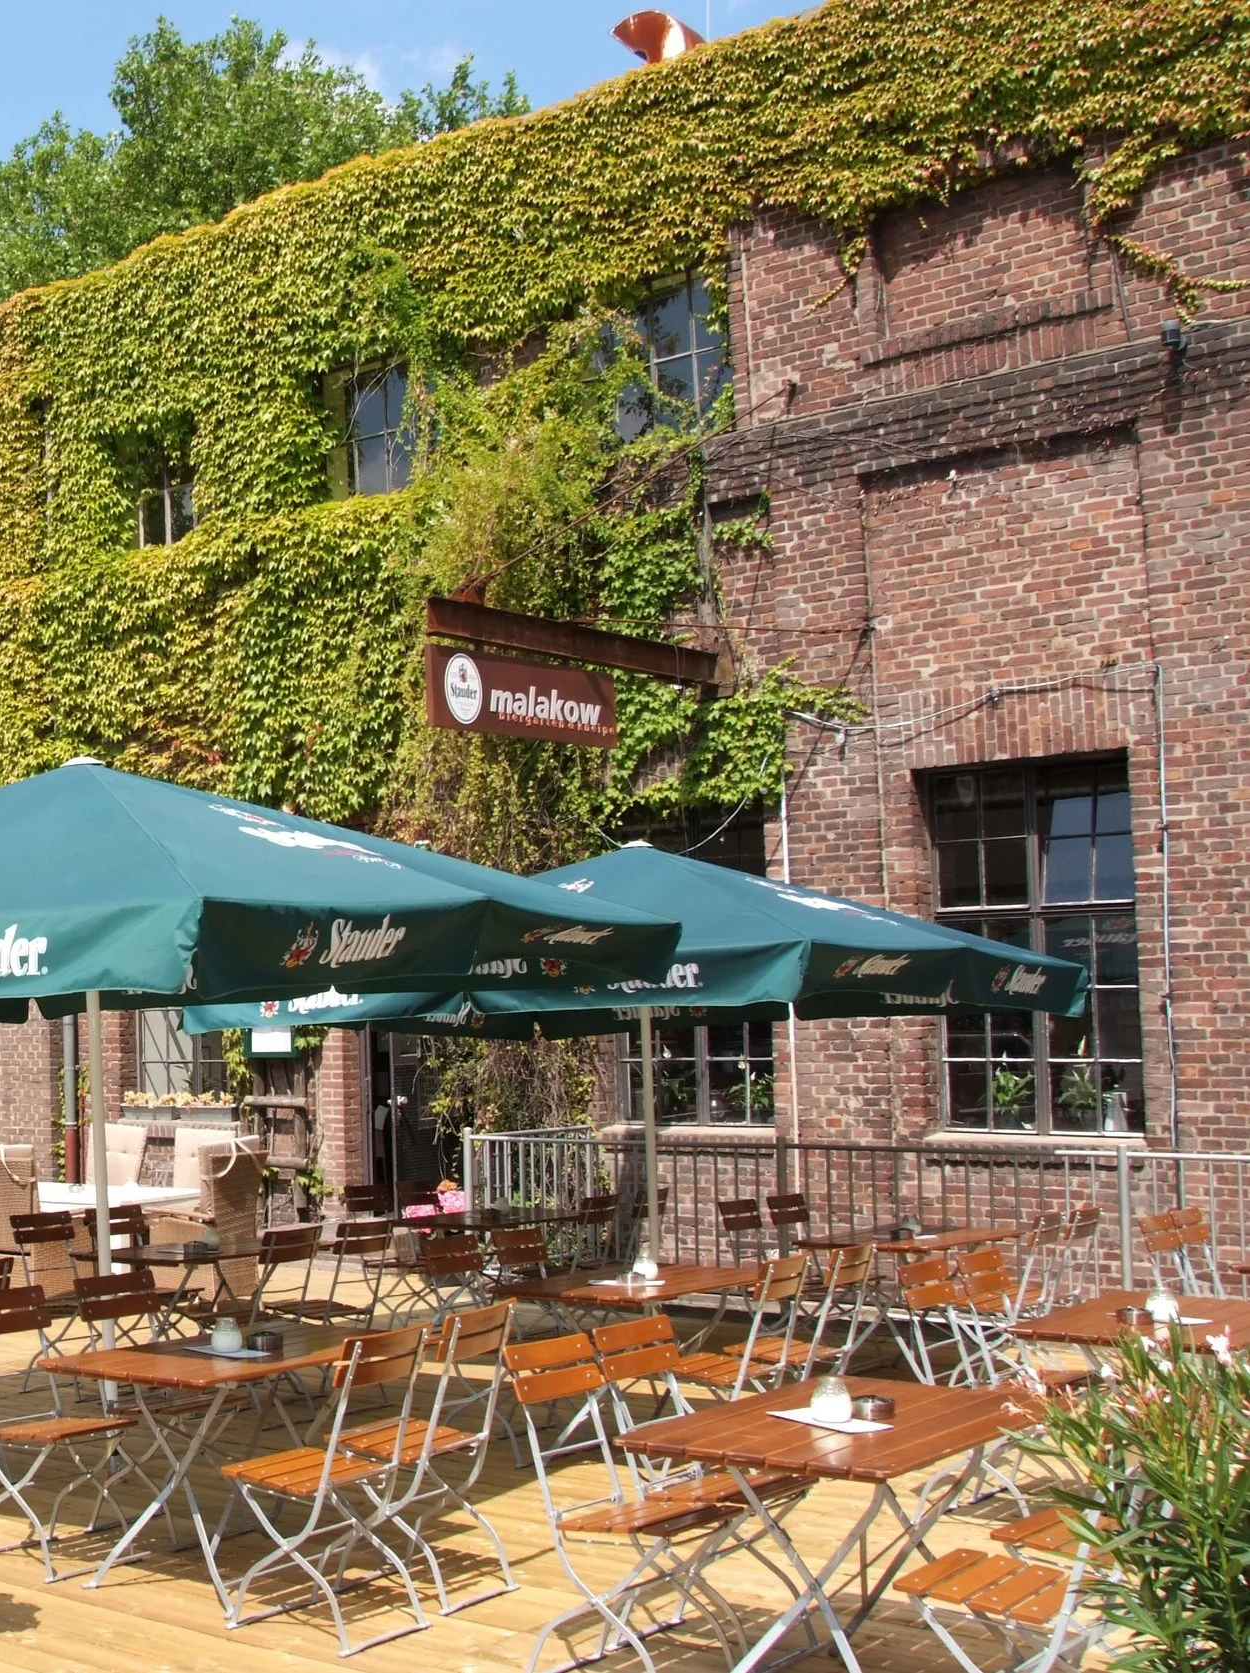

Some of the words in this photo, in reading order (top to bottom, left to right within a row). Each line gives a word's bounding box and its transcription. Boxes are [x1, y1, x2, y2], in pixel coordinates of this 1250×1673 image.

[450, 682, 478, 700] Stauder
[490, 686, 601, 726] malakow
[319, 913, 407, 968] Stauder
